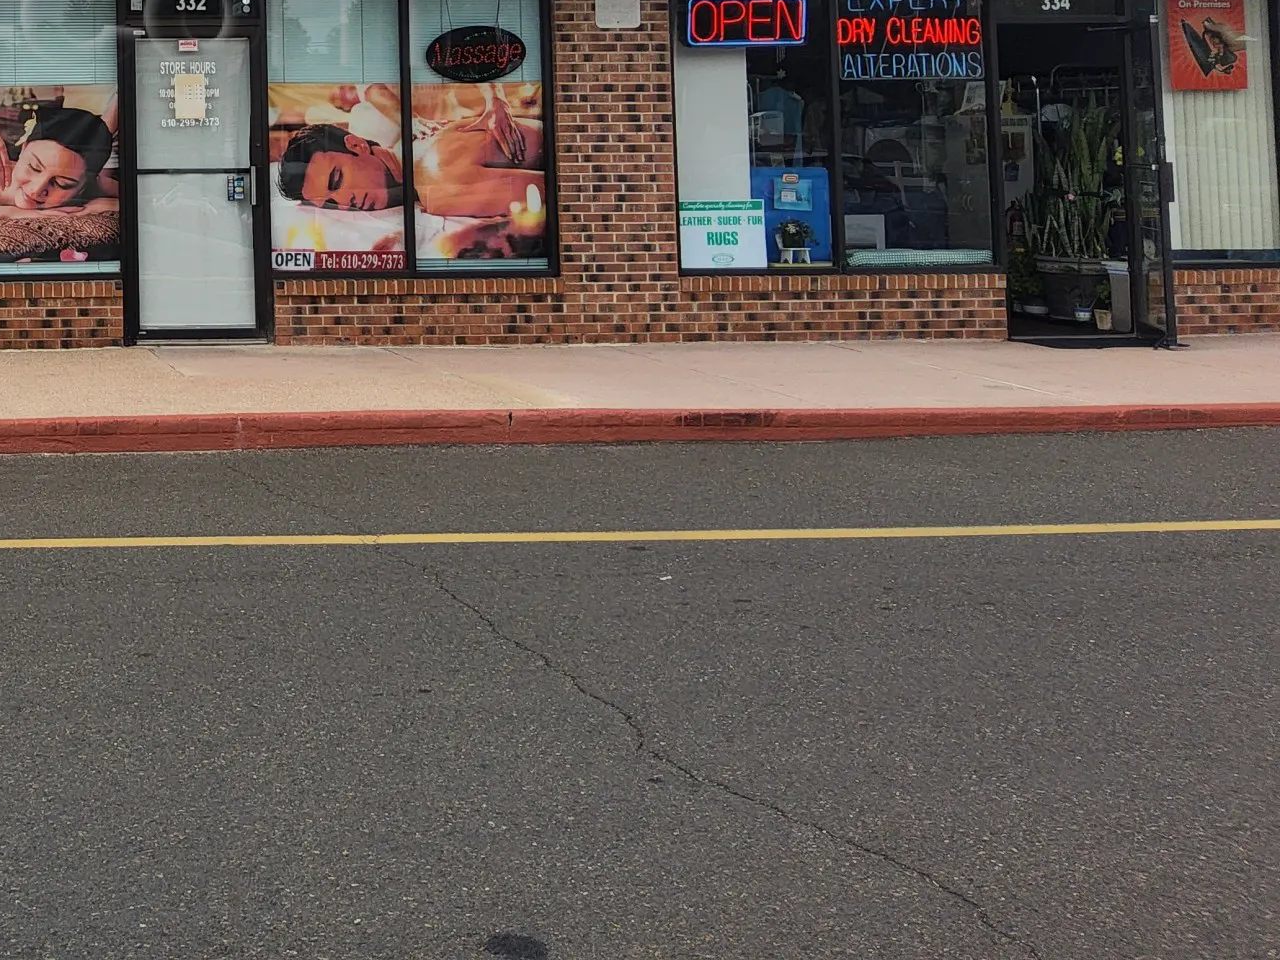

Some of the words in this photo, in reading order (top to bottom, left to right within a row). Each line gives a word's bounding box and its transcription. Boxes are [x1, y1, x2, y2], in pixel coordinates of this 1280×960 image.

[1178, 0, 1192, 8] On
[1193, 0, 1231, 8] Premises
[690, 0, 804, 42] OPEN
[837, 18, 876, 44] DRY
[886, 17, 980, 44] CLEANING
[431, 43, 522, 69] Massage
[160, 61, 186, 75] STORE
[189, 61, 216, 74] HOURS
[843, 52, 982, 79] ALTERATIONS
[161, 118, 220, 127] 610-299-7373
[718, 216, 741, 225] SUEDE
[748, 216, 763, 225] FUR
[707, 231, 739, 246] RUGS
[275, 253, 311, 266] OPEN
[321, 254, 340, 268] Tel:
[341, 254, 404, 268] 610-299-7373
